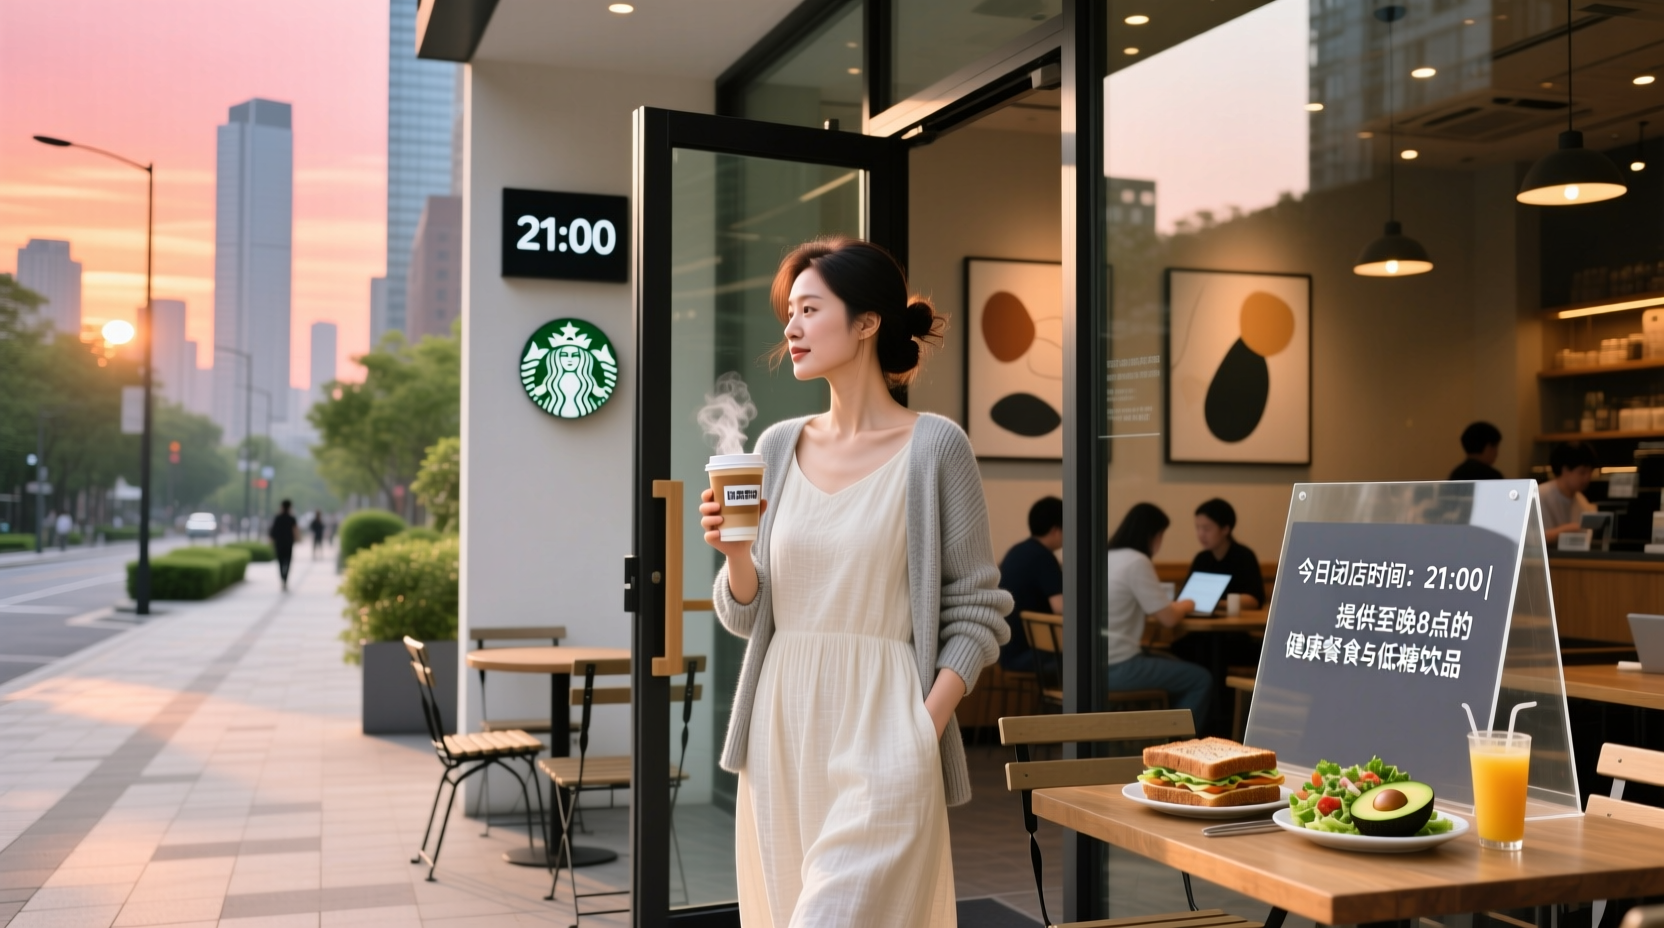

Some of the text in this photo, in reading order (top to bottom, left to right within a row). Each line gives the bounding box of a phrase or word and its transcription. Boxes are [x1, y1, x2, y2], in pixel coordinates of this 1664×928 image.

[516, 215, 616, 255] 21:00
[1335, 602, 1473, 641] 提供至晚8点的
